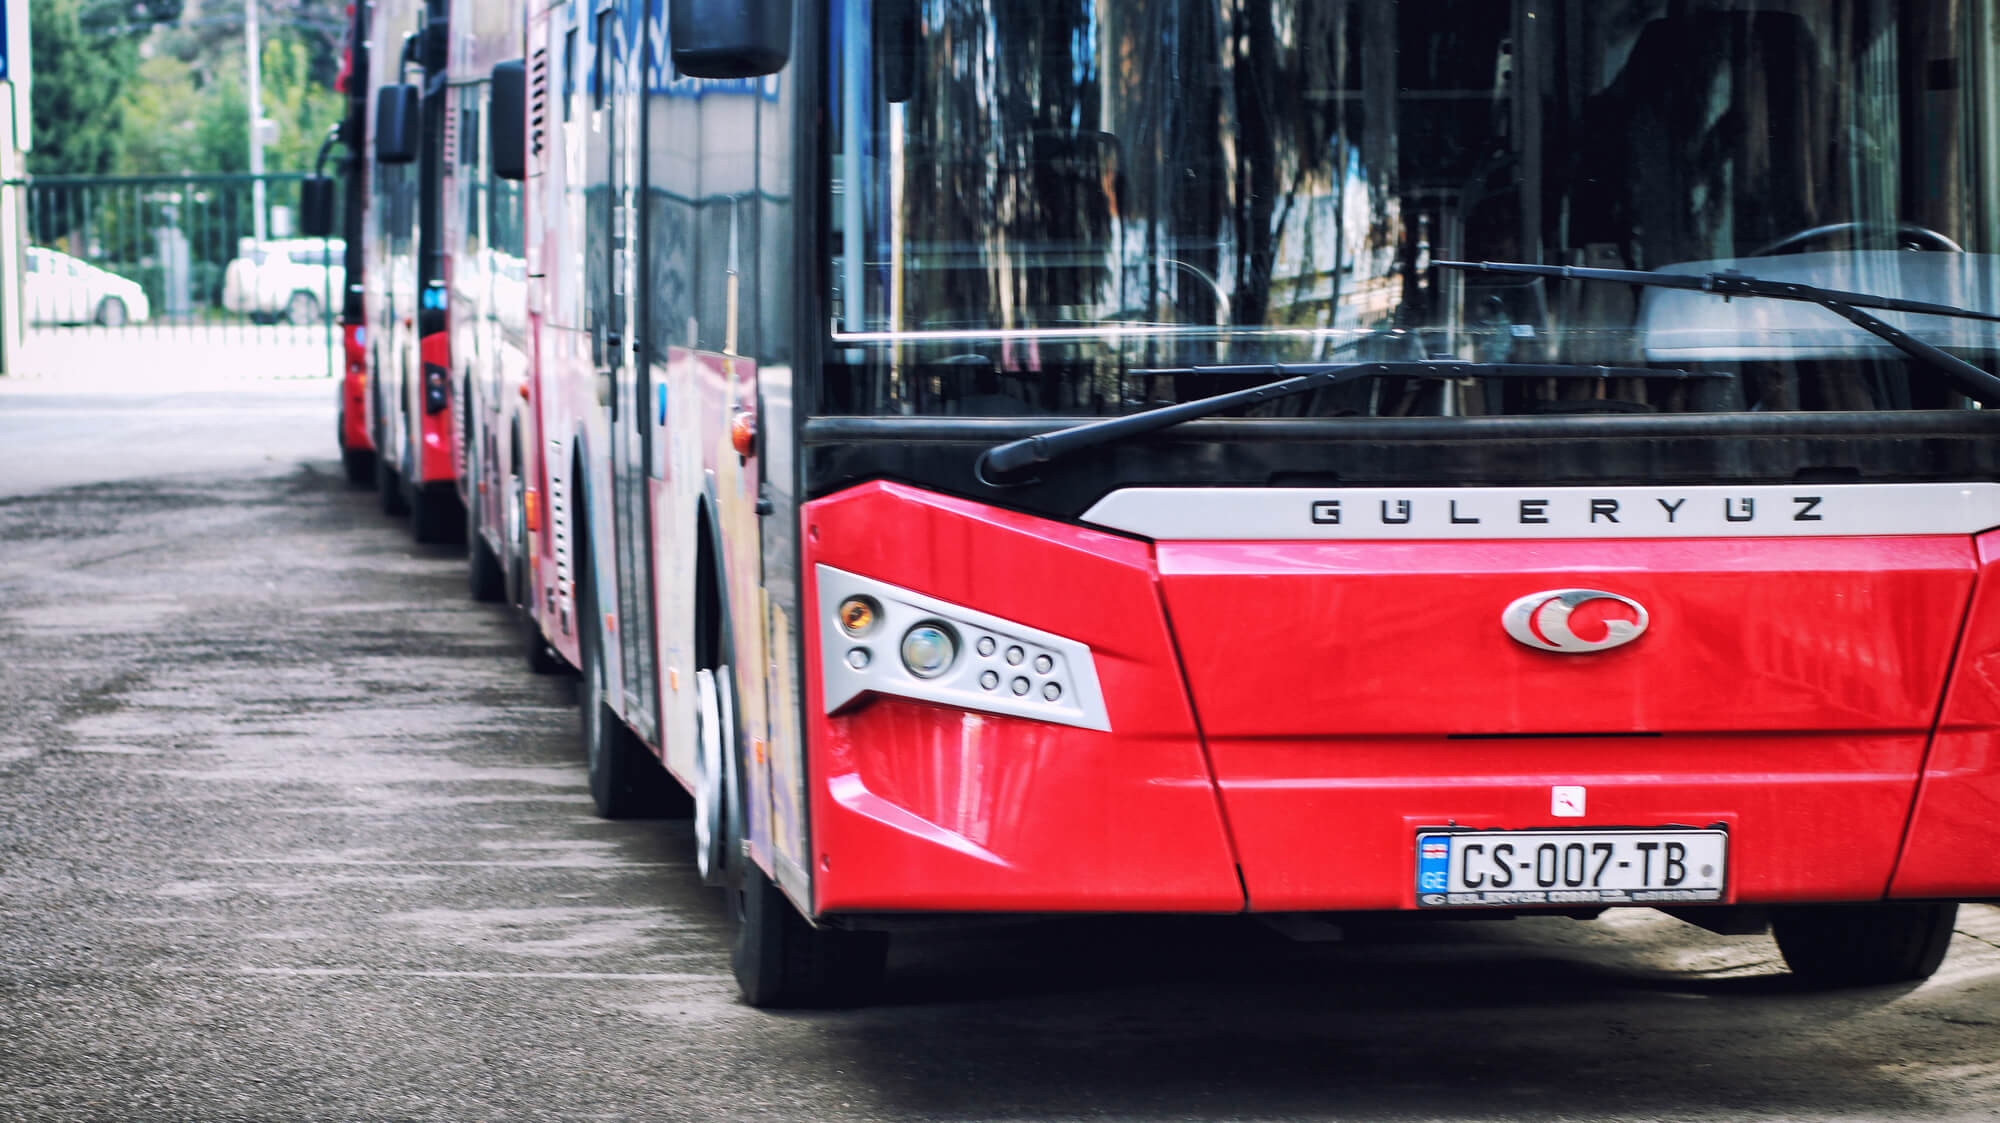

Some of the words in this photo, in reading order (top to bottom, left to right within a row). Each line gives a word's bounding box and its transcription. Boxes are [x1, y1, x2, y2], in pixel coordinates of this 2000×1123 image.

[1310, 496, 1823, 525] GÜLERYÜZ
[1462, 841, 1687, 888] CS-007-TB
[1421, 871, 1448, 890] GE
